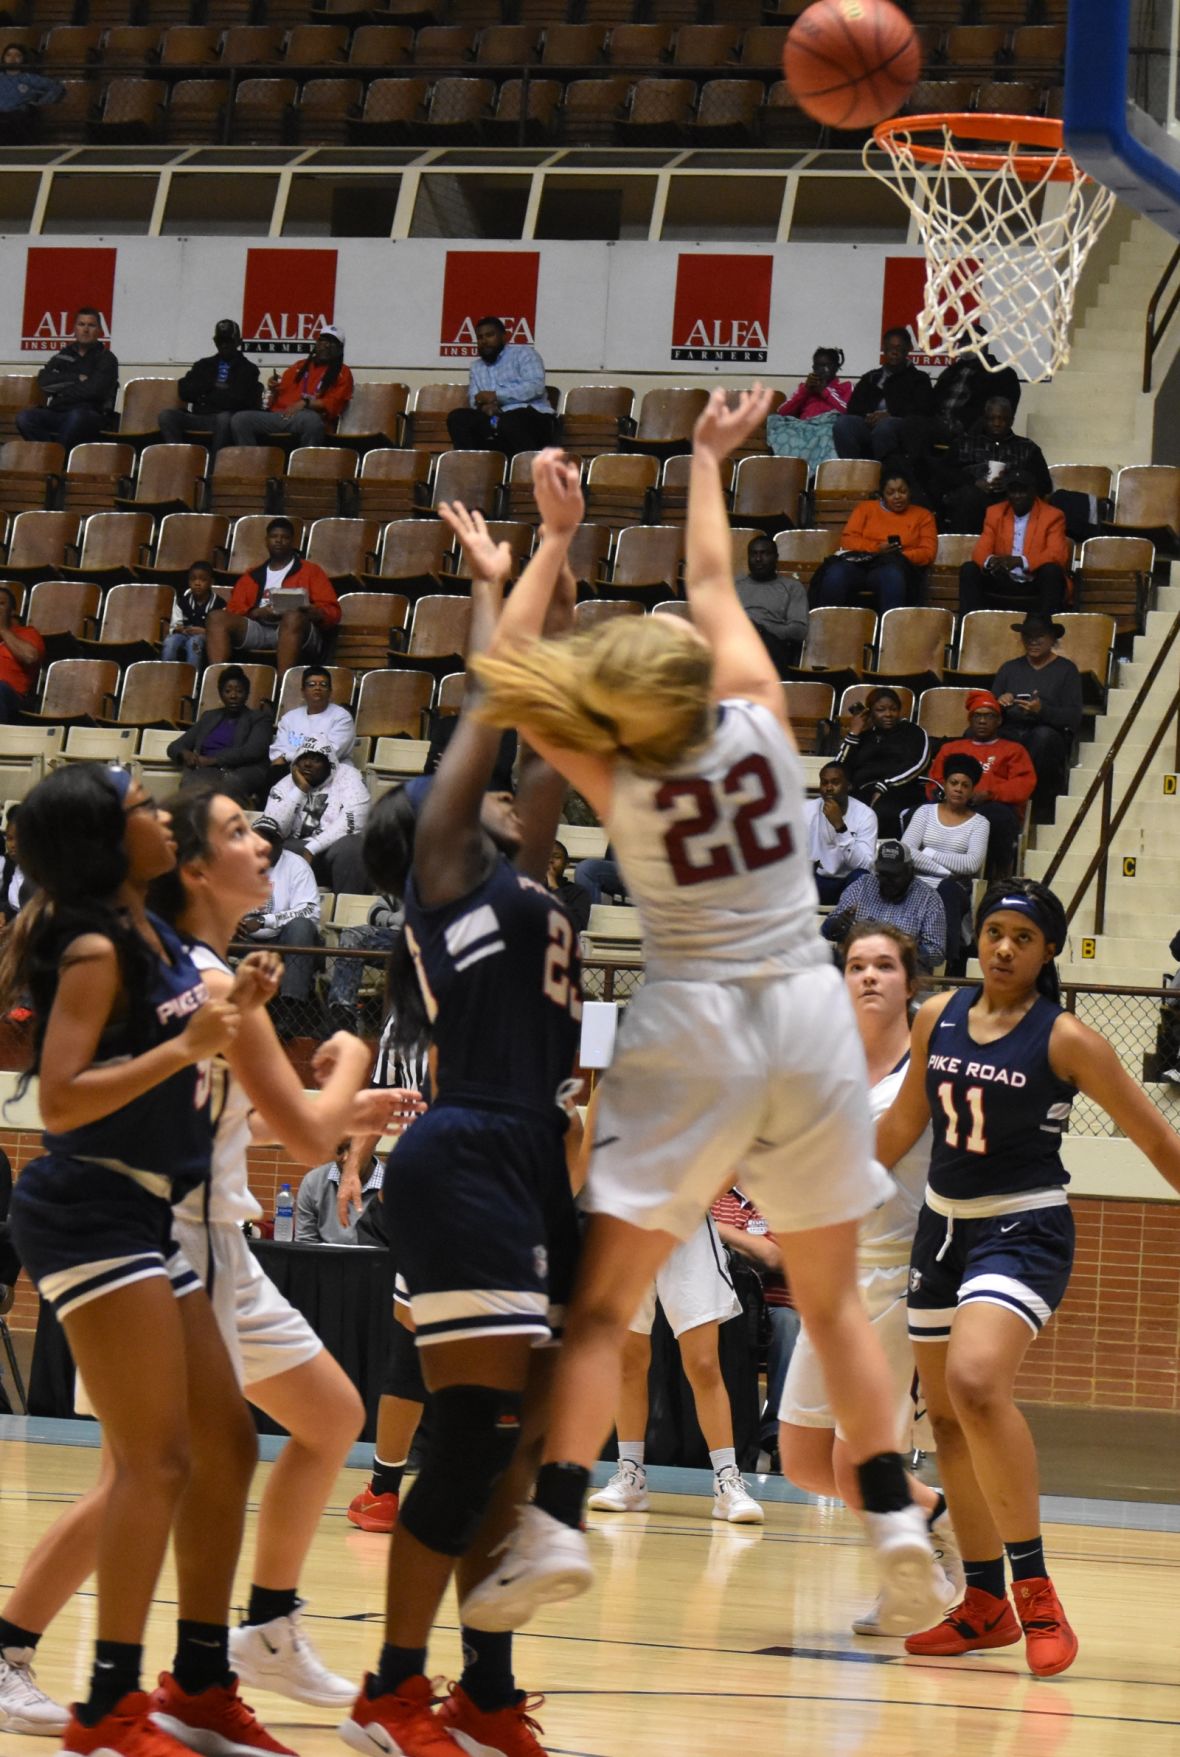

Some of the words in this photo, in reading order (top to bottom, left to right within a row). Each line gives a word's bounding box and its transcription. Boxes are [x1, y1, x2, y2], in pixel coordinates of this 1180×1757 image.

[33, 311, 111, 337] ALA
[253, 313, 329, 340] ALFA
[453, 316, 535, 343] AFA
[684, 319, 768, 347] ALFA
[675, 350, 764, 360] FARMERS
[1165, 776, 1177, 793] D
[655, 753, 795, 887] 22
[1124, 858, 1135, 876] C
[1083, 939, 1095, 957] B
[928, 1054, 962, 1074] PIKE
[965, 1062, 1027, 1088] ROAD
[938, 1082, 987, 1156] 11
